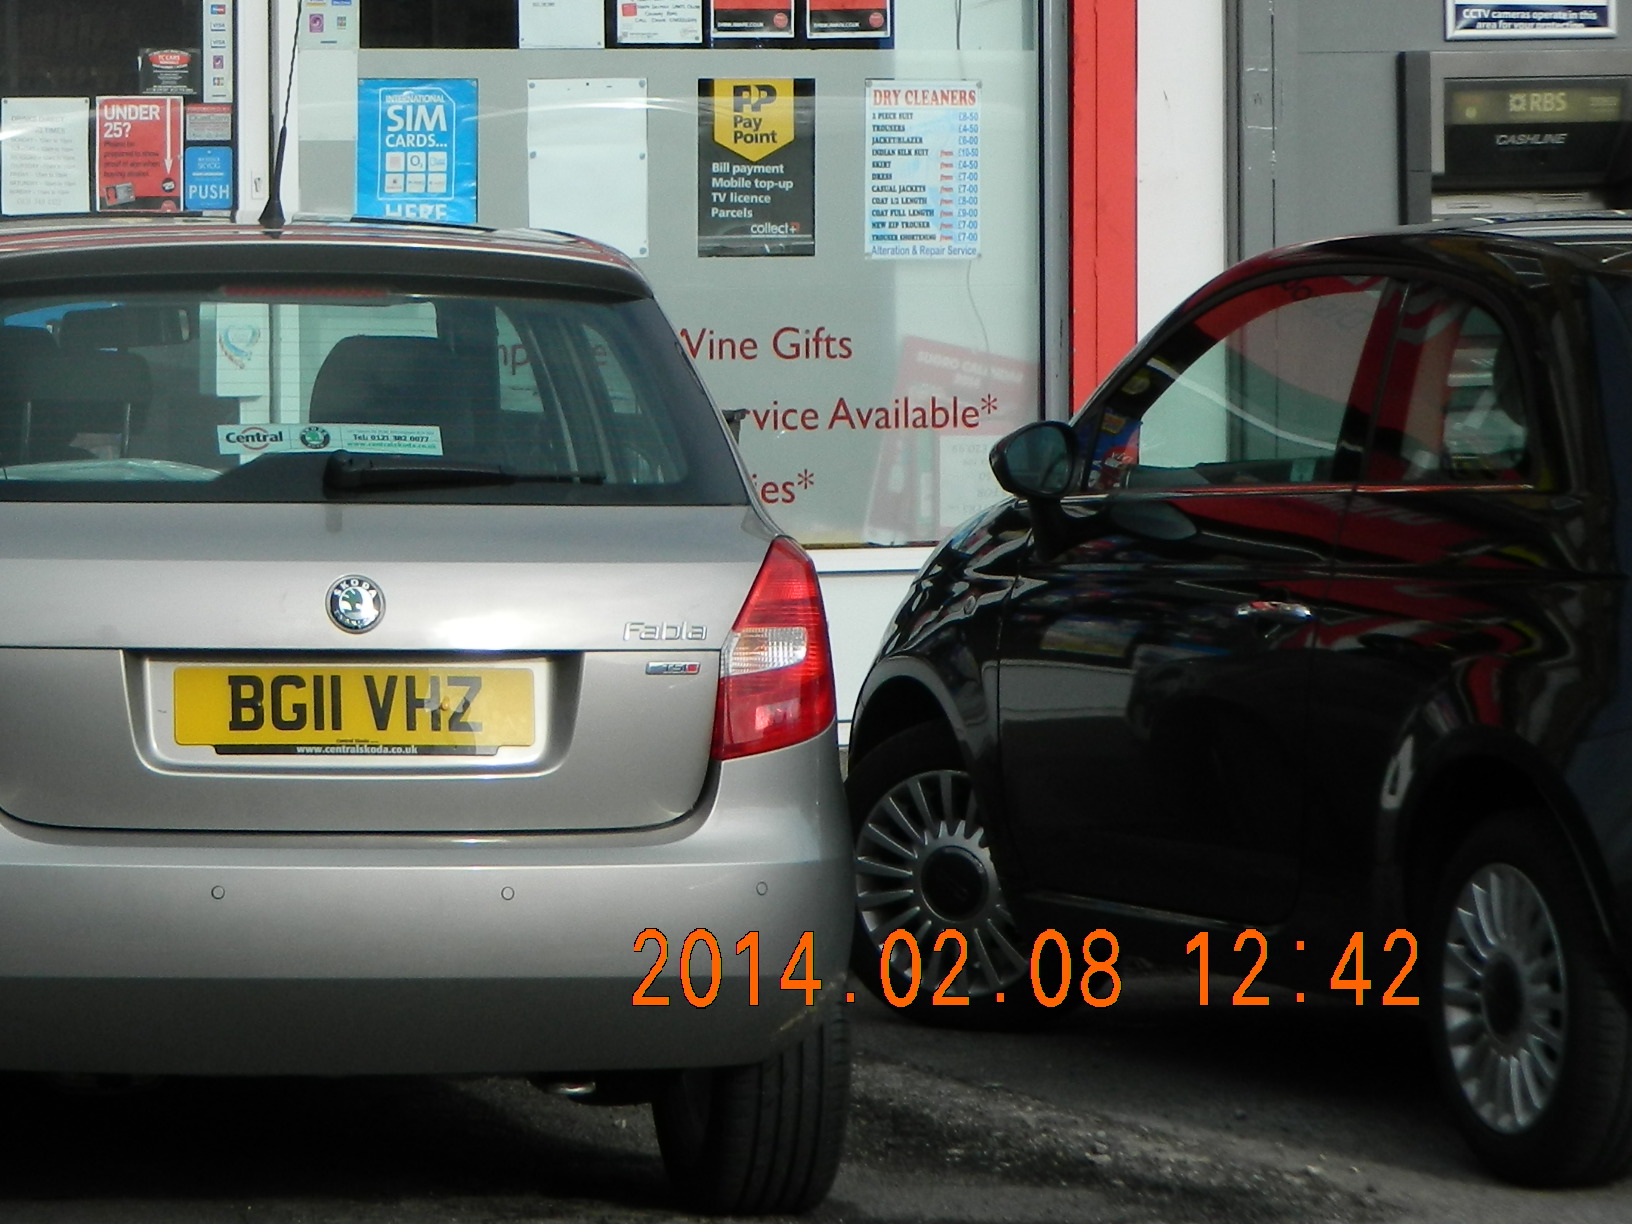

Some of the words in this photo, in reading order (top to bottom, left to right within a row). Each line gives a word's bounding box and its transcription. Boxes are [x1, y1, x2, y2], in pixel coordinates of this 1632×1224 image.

[1462, 8, 1490, 19] CCTV
[1491, 10, 1531, 19] cameras
[1532, 10, 1568, 21] operate
[1568, 10, 1578, 20] in
[1579, 10, 1598, 20] this
[1476, 22, 1497, 30] area
[1498, 20, 1512, 30] for
[1513, 21, 1535, 30] your
[385, 94, 445, 103] INTERNATIONAL
[872, 89, 901, 106] DRY
[904, 89, 977, 106] CLEANERS
[1529, 92, 1567, 112] RBS
[103, 104, 161, 121] UNDER
[387, 104, 448, 132] SIM
[733, 115, 763, 131] Pay
[871, 124, 906, 132] TROUSERS
[958, 124, 979, 133] £4-50
[103, 121, 132, 139] 25?
[385, 133, 448, 148] CARDS...
[733, 130, 778, 144] Point
[1495, 133, 1568, 146] CASHLINE
[871, 148, 896, 156] INDIAN
[897, 148, 912, 156] SILK
[913, 148, 929, 156] SUIT
[711, 162, 730, 174] Bill
[732, 162, 784, 176] payment
[957, 160, 979, 169] £4-50
[871, 172, 892, 180] DRESS
[957, 172, 978, 181] £7-00
[711, 177, 751, 188] Mobile
[754, 178, 794, 191] top-up
[871, 185, 897, 193] CASUAL
[898, 185, 926, 194] JACKETS
[957, 184, 978, 193] £7-00
[188, 184, 229, 200] PUSH
[711, 192, 727, 203] TV
[729, 192, 772, 204] licence
[871, 197, 888, 205] COAT
[901, 197, 928, 205] LENGTH
[711, 207, 754, 218] Parcels
[871, 209, 888, 217] COAT
[890, 209, 906, 217] FULL
[908, 209, 935, 217] LENGTH
[871, 221, 886, 229] NEW
[888, 221, 900, 229] ZIP
[901, 221, 931, 229] TROUSER
[957, 221, 978, 230] £7-00
[957, 233, 978, 242] £7-00
[871, 245, 909, 256] Alteration
[911, 245, 918, 256] &
[919, 245, 946, 257] Repair
[947, 245, 977, 256] Service
[771, 326, 854, 360] Gifts
[225, 431, 284, 445] Central
[370, 434, 389, 442] 0121
[623, 621, 709, 642] Fabia
[368, 674, 484, 733] VHZ
[295, 744, 419, 756] www.centralskoda.co.uk
